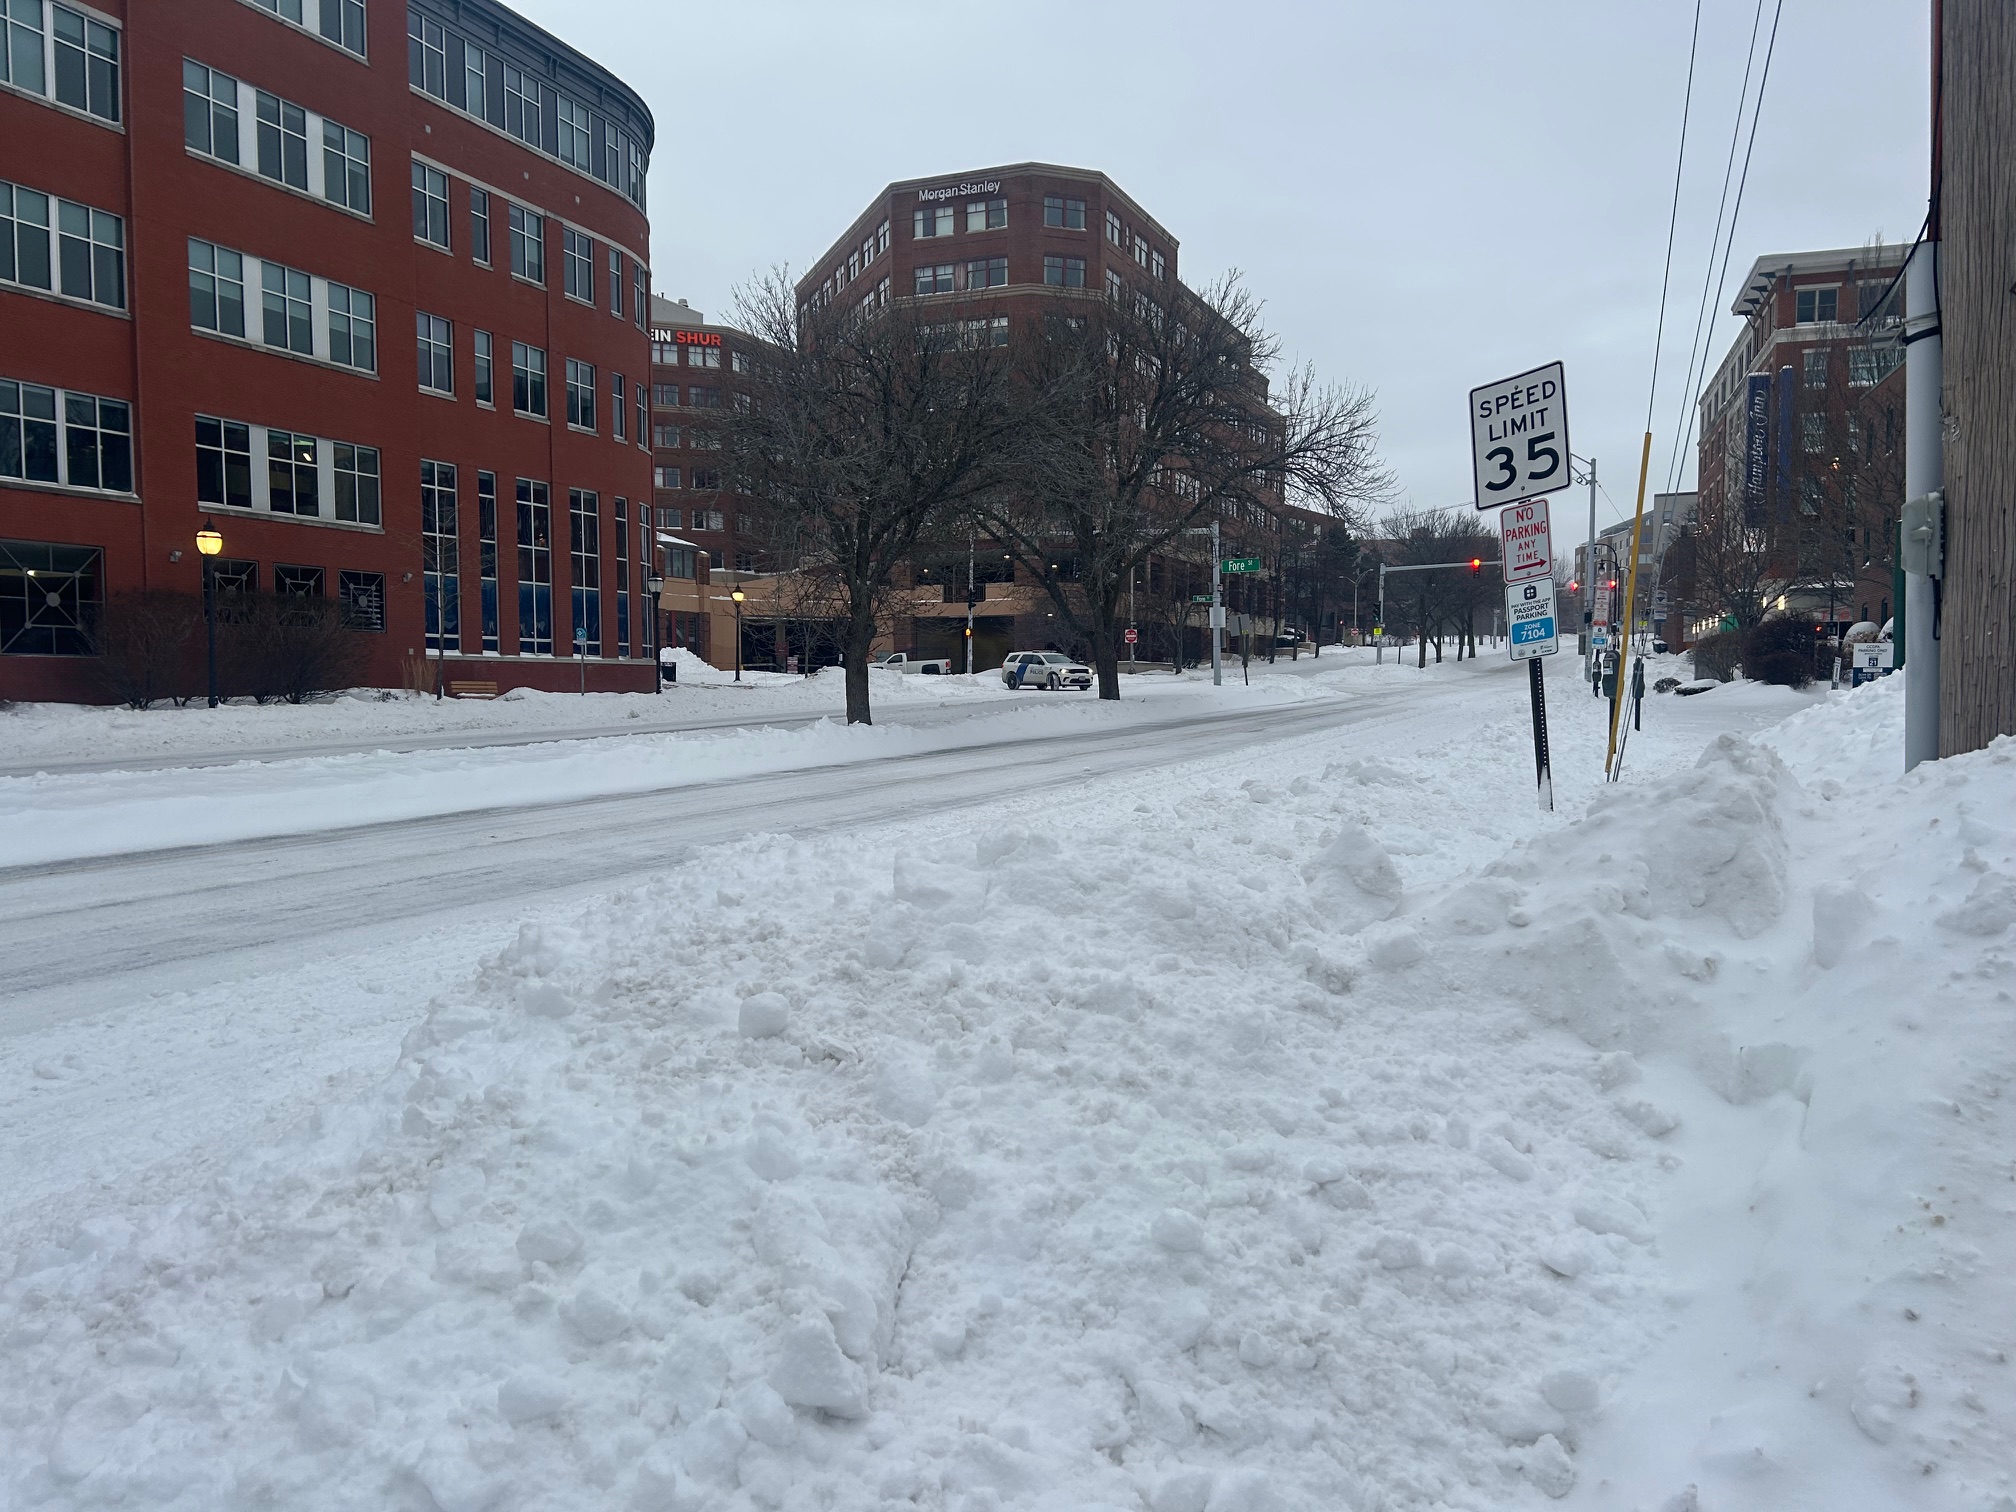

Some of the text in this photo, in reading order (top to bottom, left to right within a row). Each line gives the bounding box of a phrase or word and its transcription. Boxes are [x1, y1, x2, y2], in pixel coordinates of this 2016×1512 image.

[918, 180, 1001, 202] Morgan Stanley
[676, 330, 721, 346] SHUR
[1479, 380, 1556, 418] SPEED
[1489, 407, 1549, 442] LIMIT
[1485, 431, 1560, 491] 35
[1516, 507, 1534, 523] NO
[1505, 520, 1547, 542] PARKING
[1518, 539, 1536, 552] ANY
[1516, 550, 1539, 563] TIME
[1228, 560, 1245, 571] Fore
[1513, 602, 1549, 615] PASSPORT
[1516, 609, 1548, 621] PARKING
[1521, 627, 1546, 641] 7104
[1523, 622, 1541, 631] ZONE
